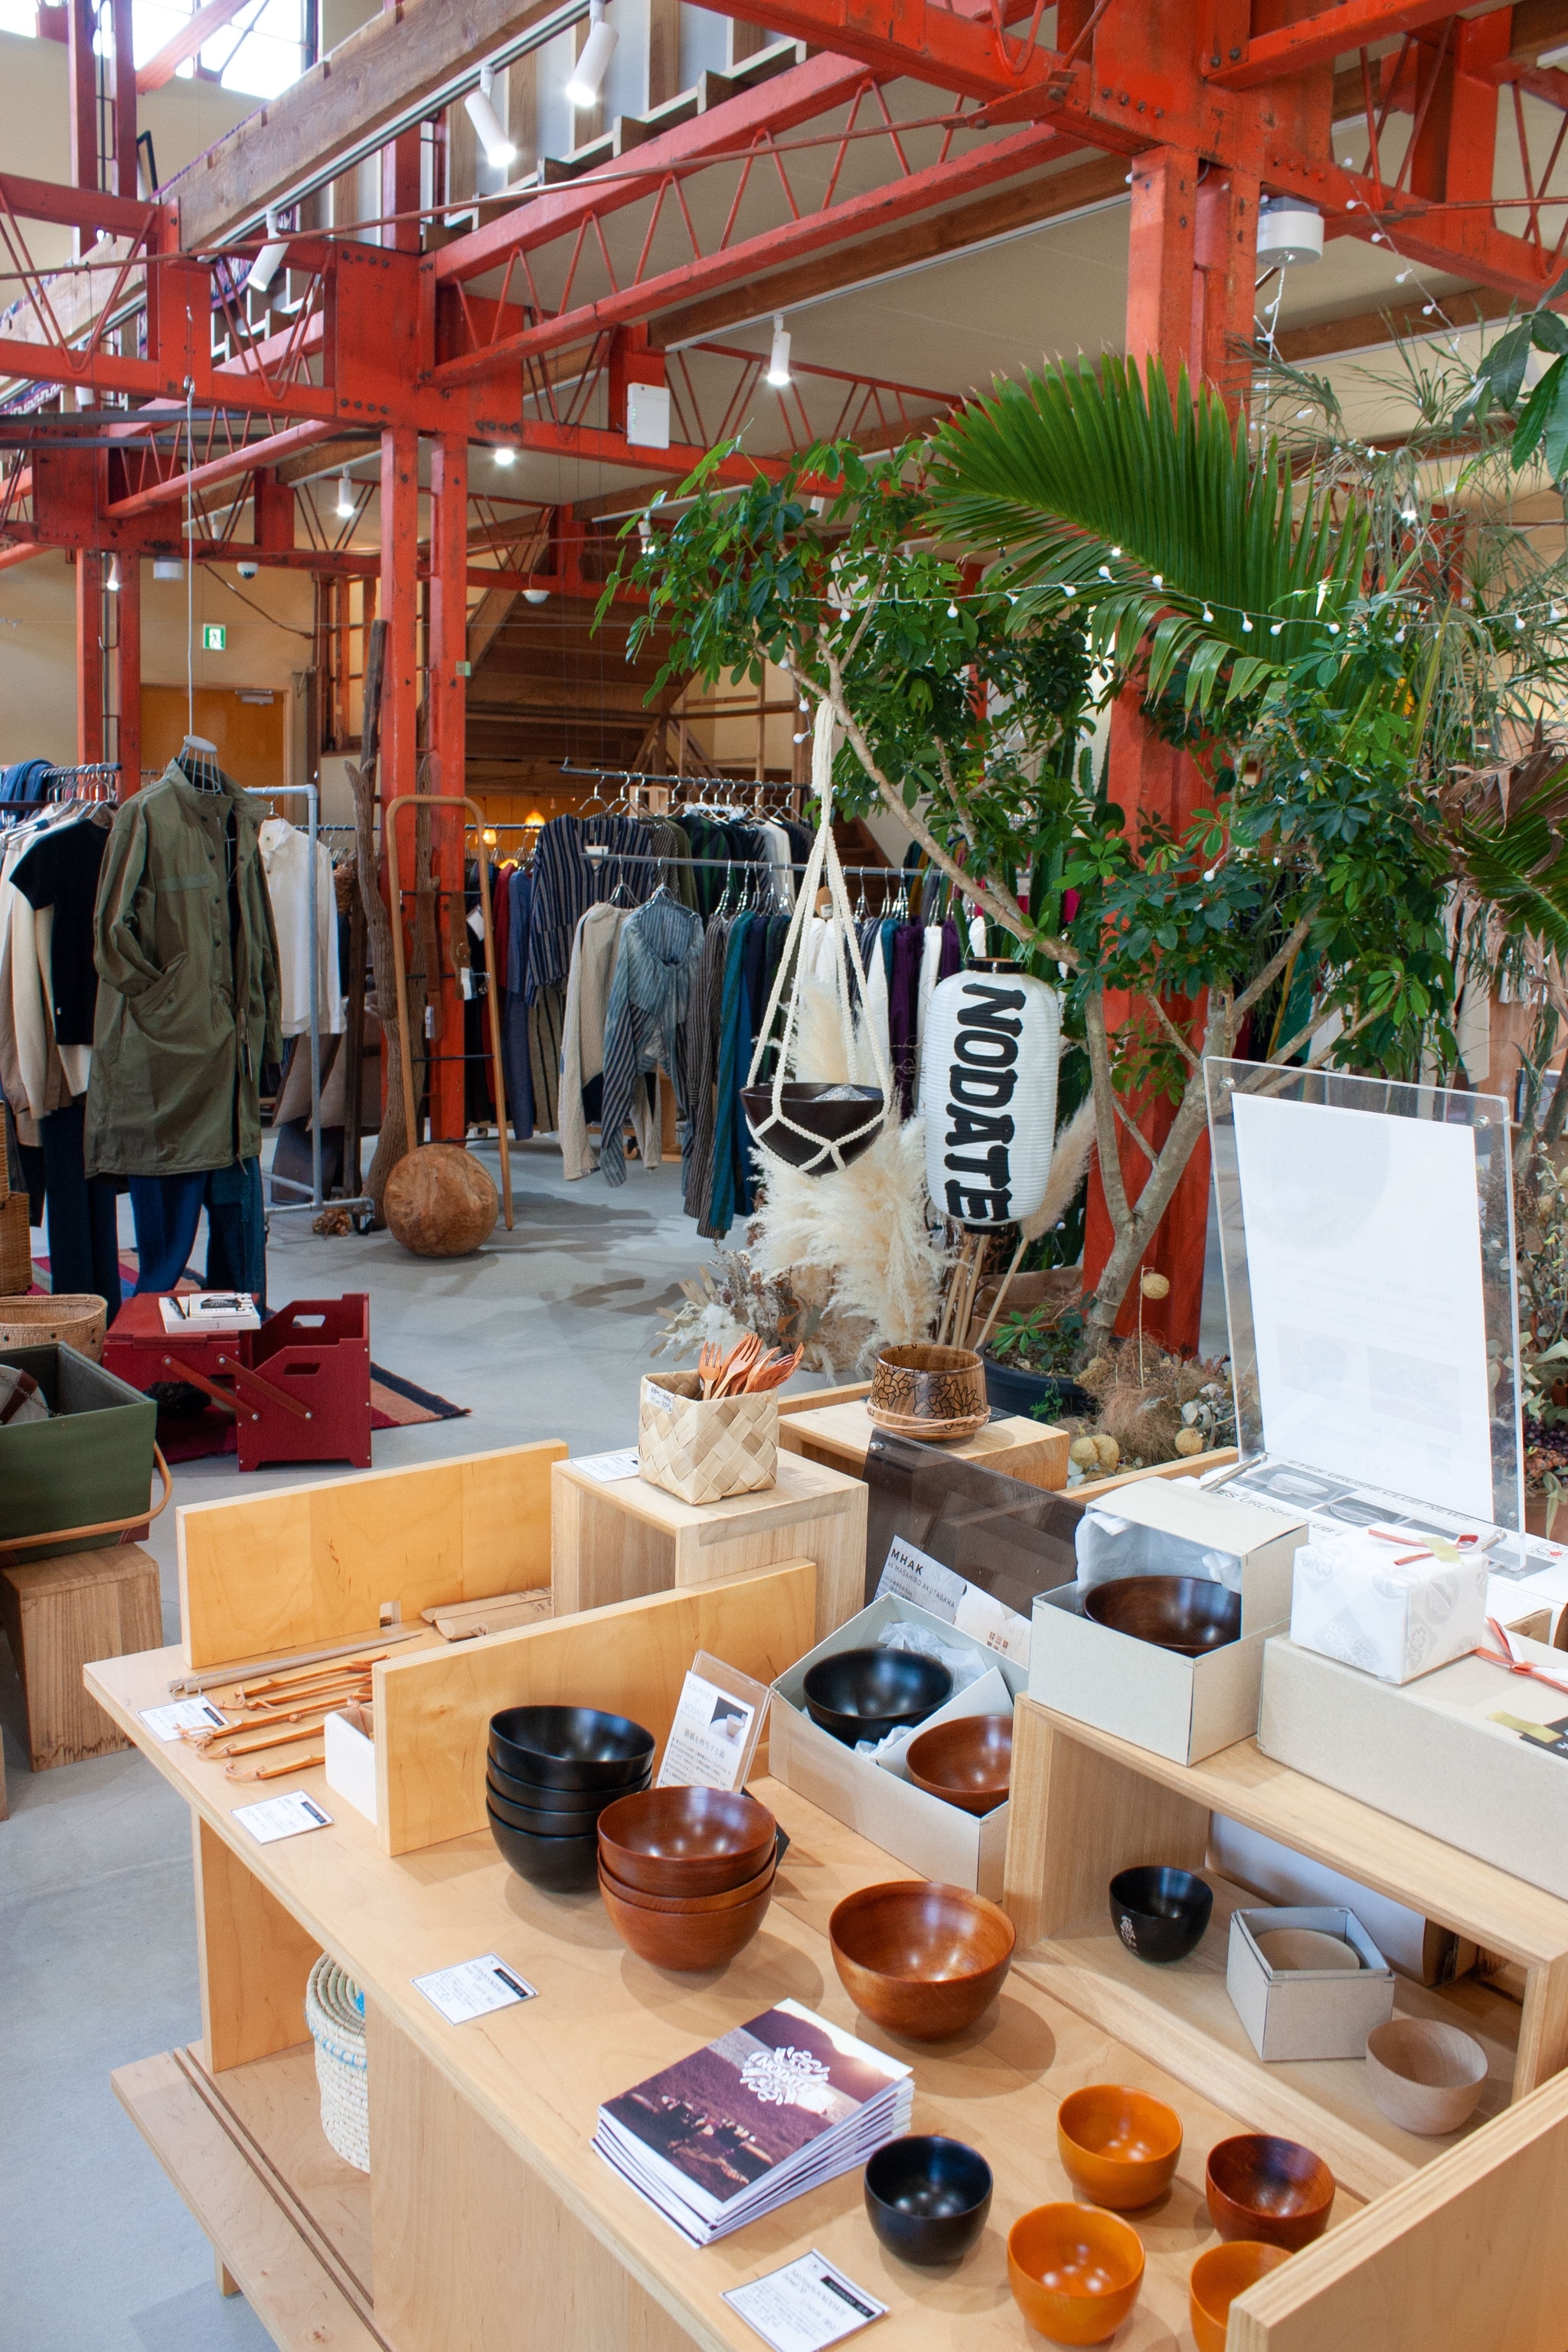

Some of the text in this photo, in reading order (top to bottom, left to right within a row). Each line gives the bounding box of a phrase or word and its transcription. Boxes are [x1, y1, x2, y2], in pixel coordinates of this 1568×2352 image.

[944, 983, 1026, 1221] NODATE
[1327, 1472, 1380, 1491] URUSHI
[891, 1548, 923, 1575] MHAK
[895, 1565, 922, 1586] MASAHIRO
[923, 1583, 956, 1607] AKUTAGAWA
